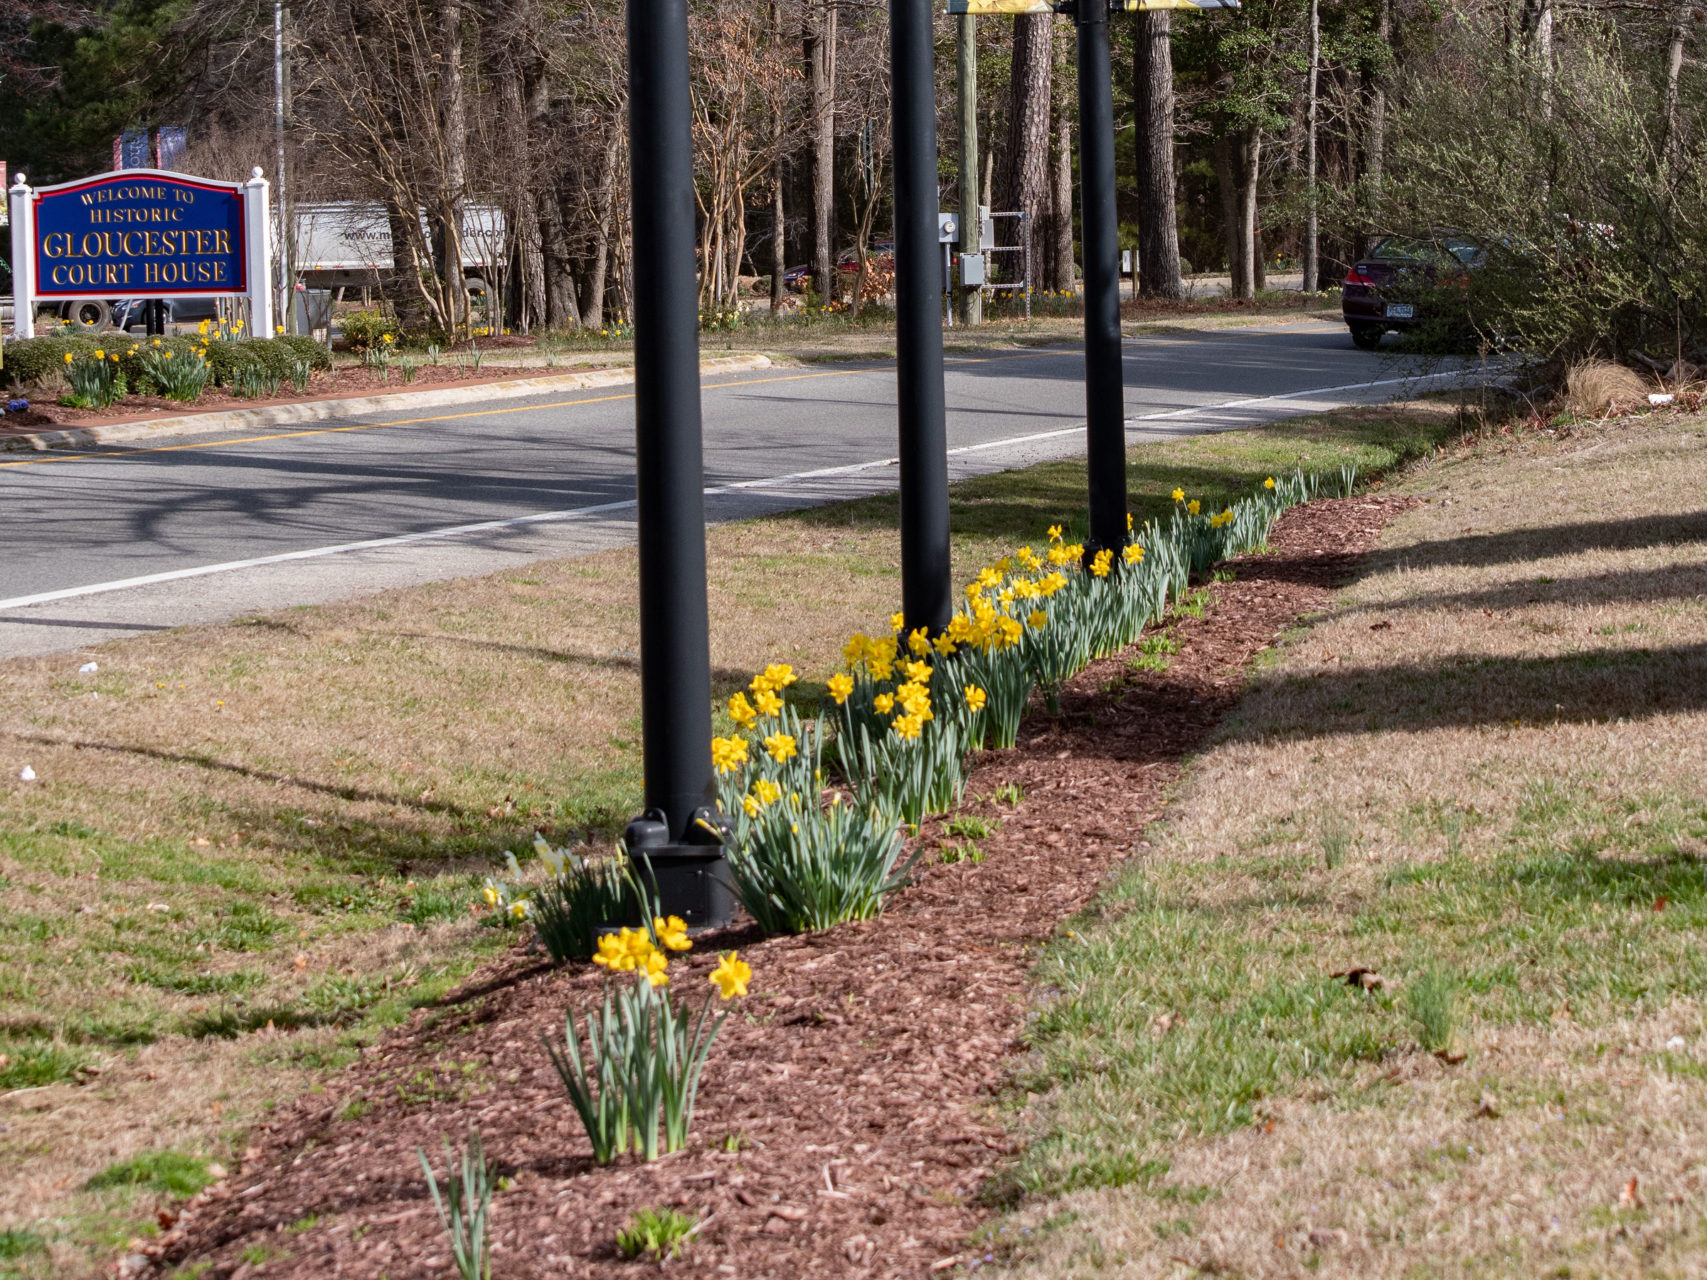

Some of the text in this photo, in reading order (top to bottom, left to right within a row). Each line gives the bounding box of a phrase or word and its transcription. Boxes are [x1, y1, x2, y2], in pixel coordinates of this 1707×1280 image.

[80, 186, 195, 206] WELCOME TO
[90, 207, 185, 224] HISTORIC
[43, 229, 233, 259] GLOUCESTER
[52, 261, 228, 286] COURT HOUSE
